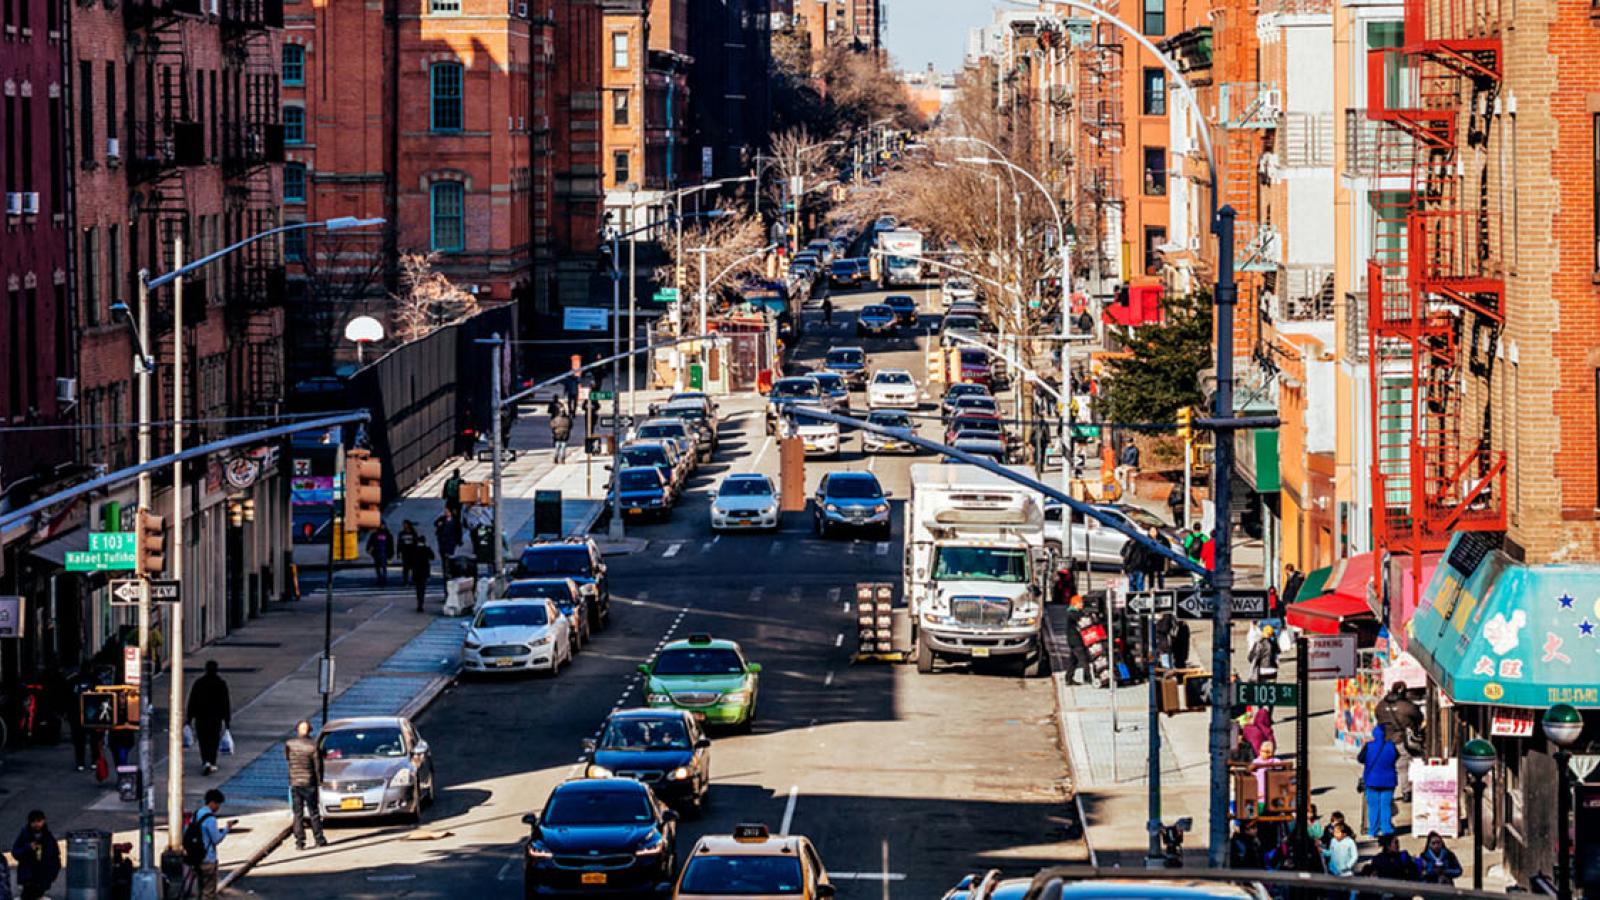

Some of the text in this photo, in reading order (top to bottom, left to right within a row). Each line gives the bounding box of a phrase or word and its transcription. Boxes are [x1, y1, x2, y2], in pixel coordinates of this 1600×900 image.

[92, 535, 99, 550] E
[103, 535, 123, 550] 103
[67, 553, 101, 564] Rafael
[1231, 598, 1262, 611] WAY
[1313, 640, 1343, 649] PARKING
[1240, 685, 1248, 703] E
[1253, 685, 1277, 704] 103
